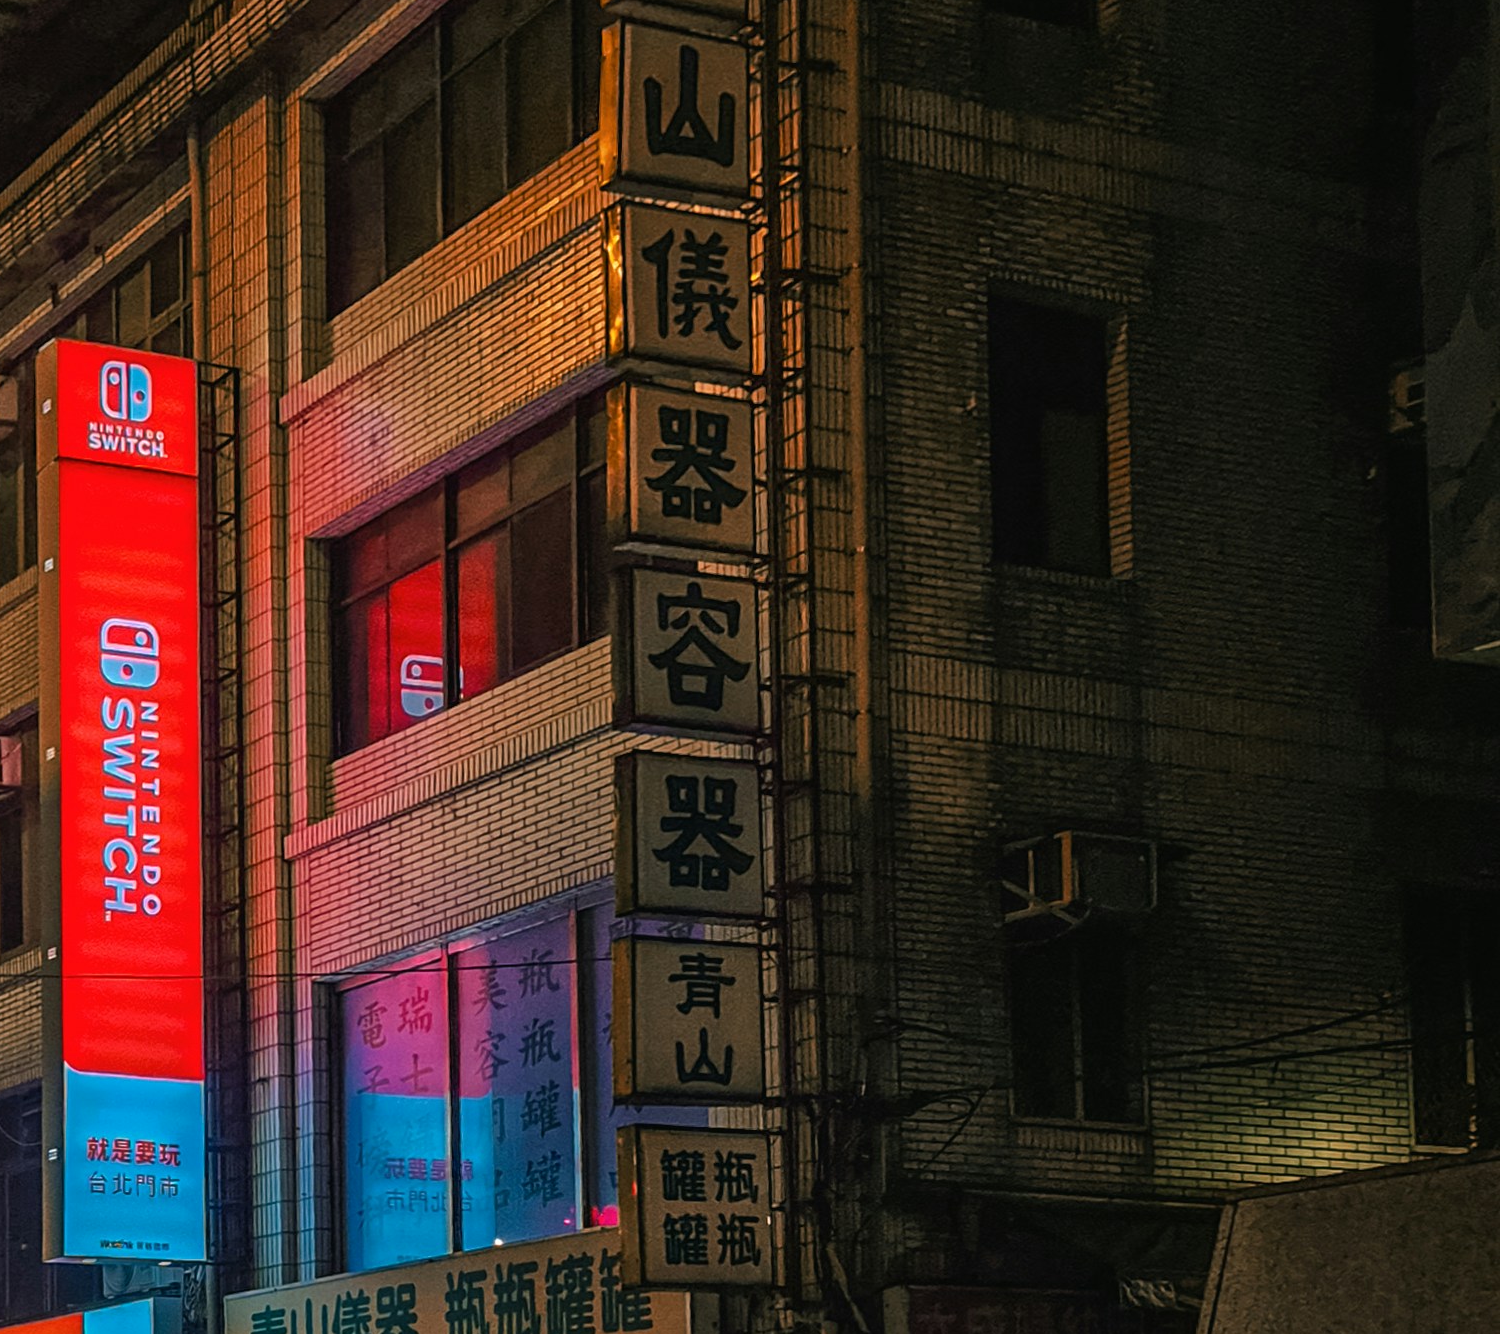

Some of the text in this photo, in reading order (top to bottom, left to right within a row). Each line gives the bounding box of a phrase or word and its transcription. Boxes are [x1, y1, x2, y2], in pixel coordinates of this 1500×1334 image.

[87, 431, 166, 459] SWITCH
[88, 421, 166, 441] NINTENDO
[101, 695, 138, 914] SWITCH
[140, 700, 162, 917] NINTENDO
[668, 951, 736, 1085] 青山
[516, 947, 564, 1210] 瓶瓶罐罐
[86, 1136, 182, 1167] 就是要玩
[88, 1170, 181, 1198] 台北門市
